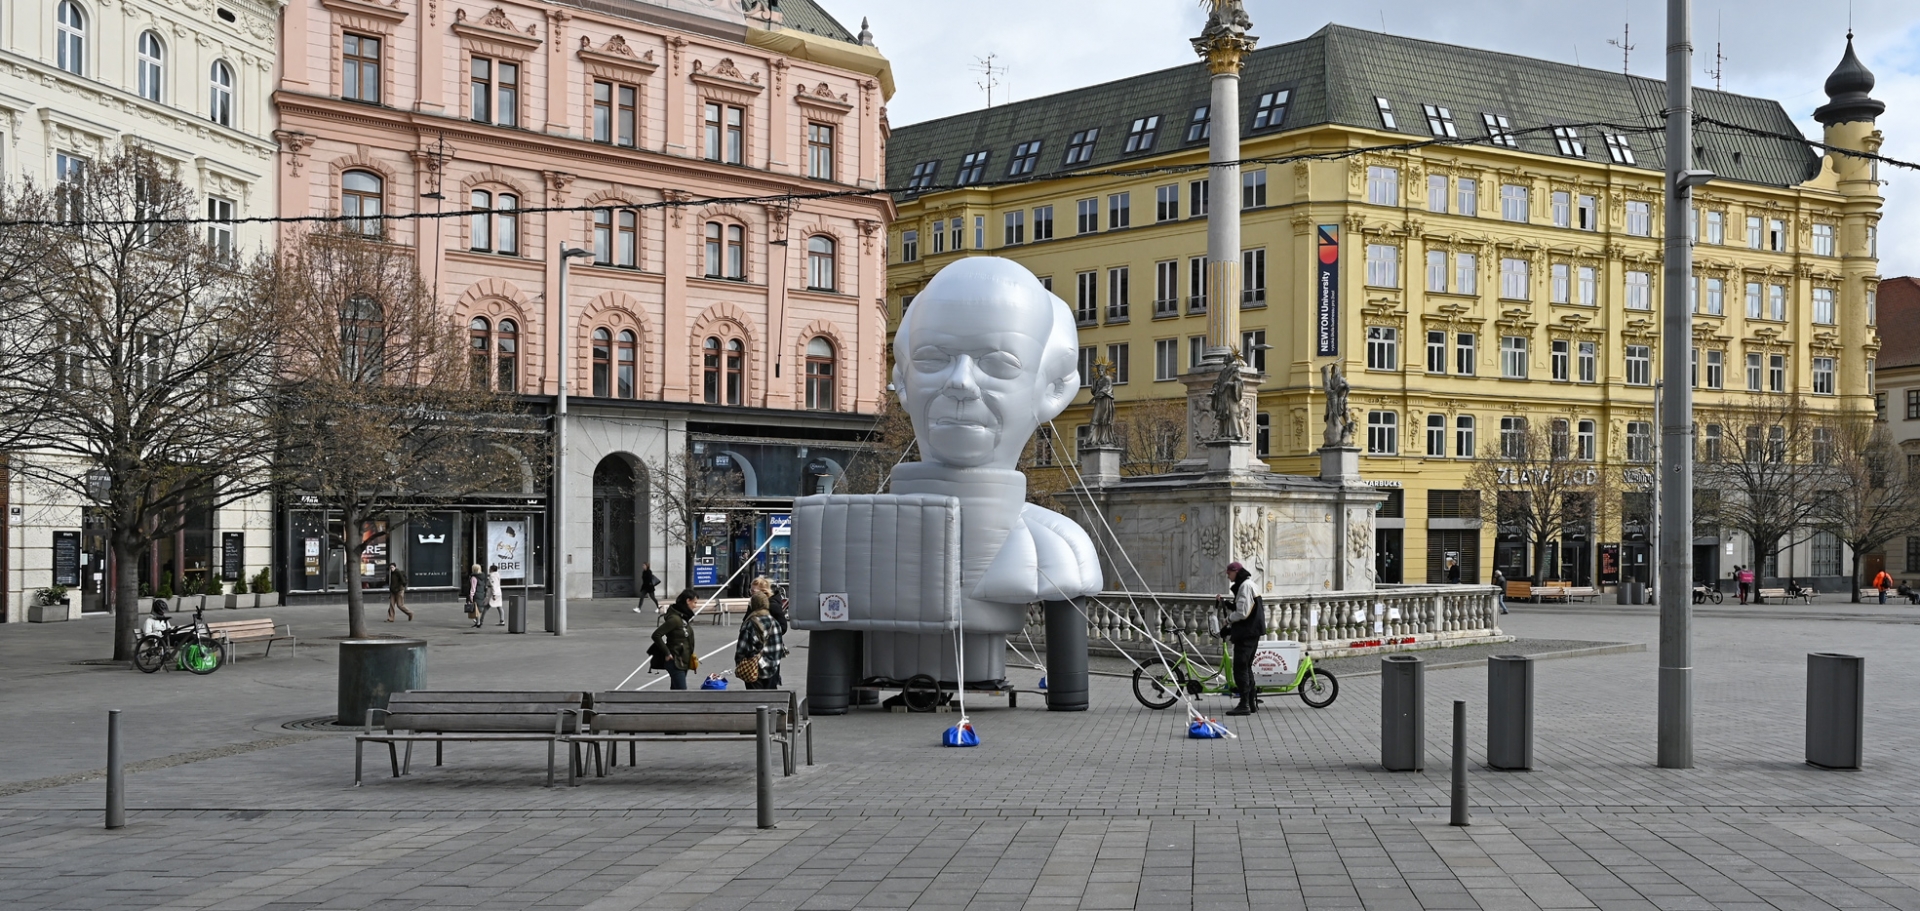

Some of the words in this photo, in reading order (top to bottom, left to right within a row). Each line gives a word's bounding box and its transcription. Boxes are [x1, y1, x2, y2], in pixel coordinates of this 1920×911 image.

[1321, 271, 1330, 312] University
[1321, 313, 1329, 352] NEWTON
[494, 562, 520, 570] IBRE
[1268, 650, 1288, 671] FUCHS
